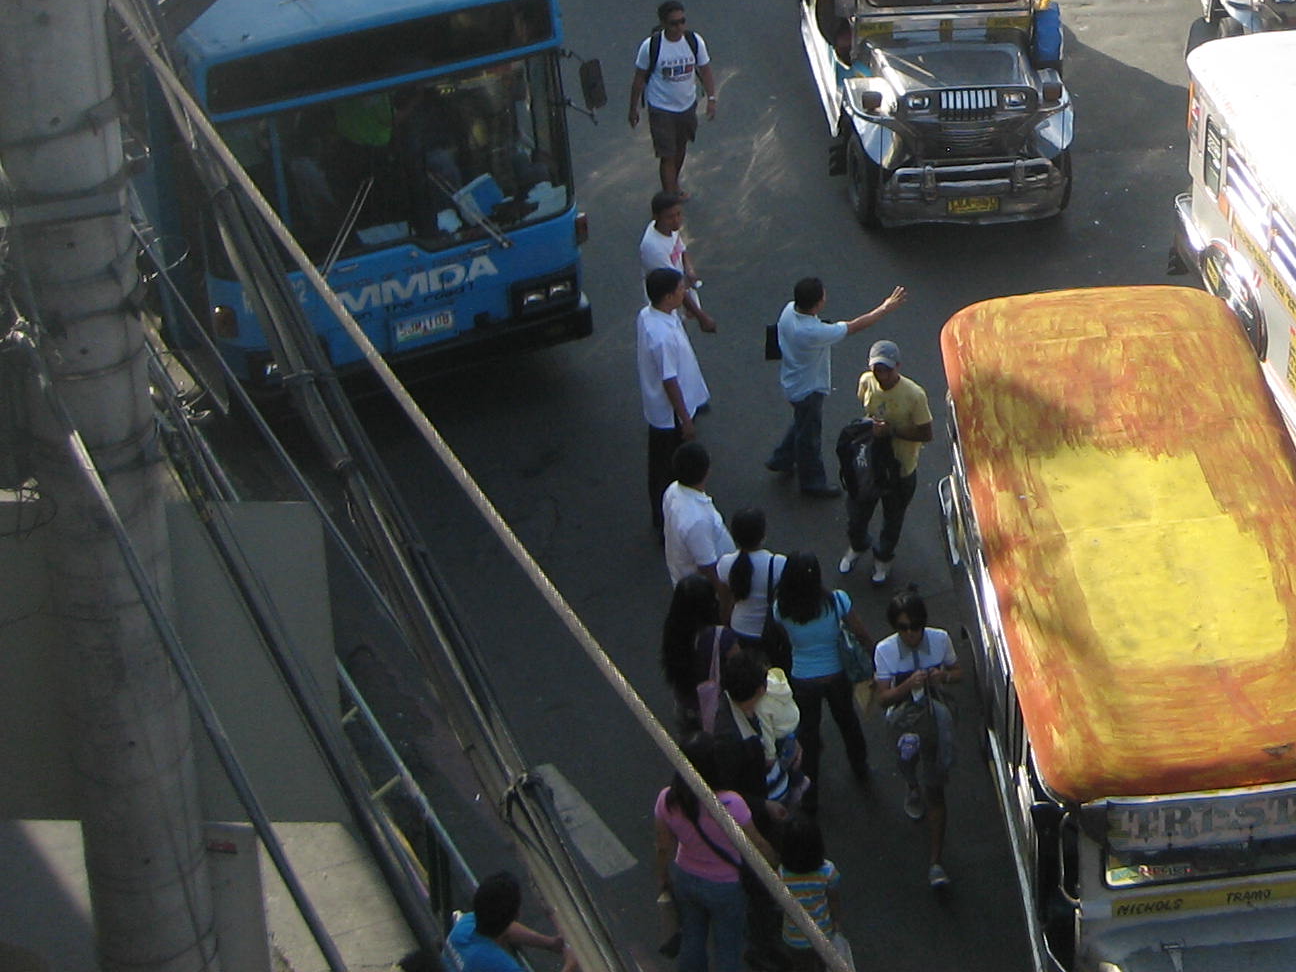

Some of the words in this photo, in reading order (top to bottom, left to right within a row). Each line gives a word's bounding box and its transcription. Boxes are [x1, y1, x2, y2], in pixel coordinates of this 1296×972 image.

[335, 255, 499, 313] MMDA
[1116, 898, 1184, 916] NICHOLS
[1226, 888, 1272, 904] TRAMO
